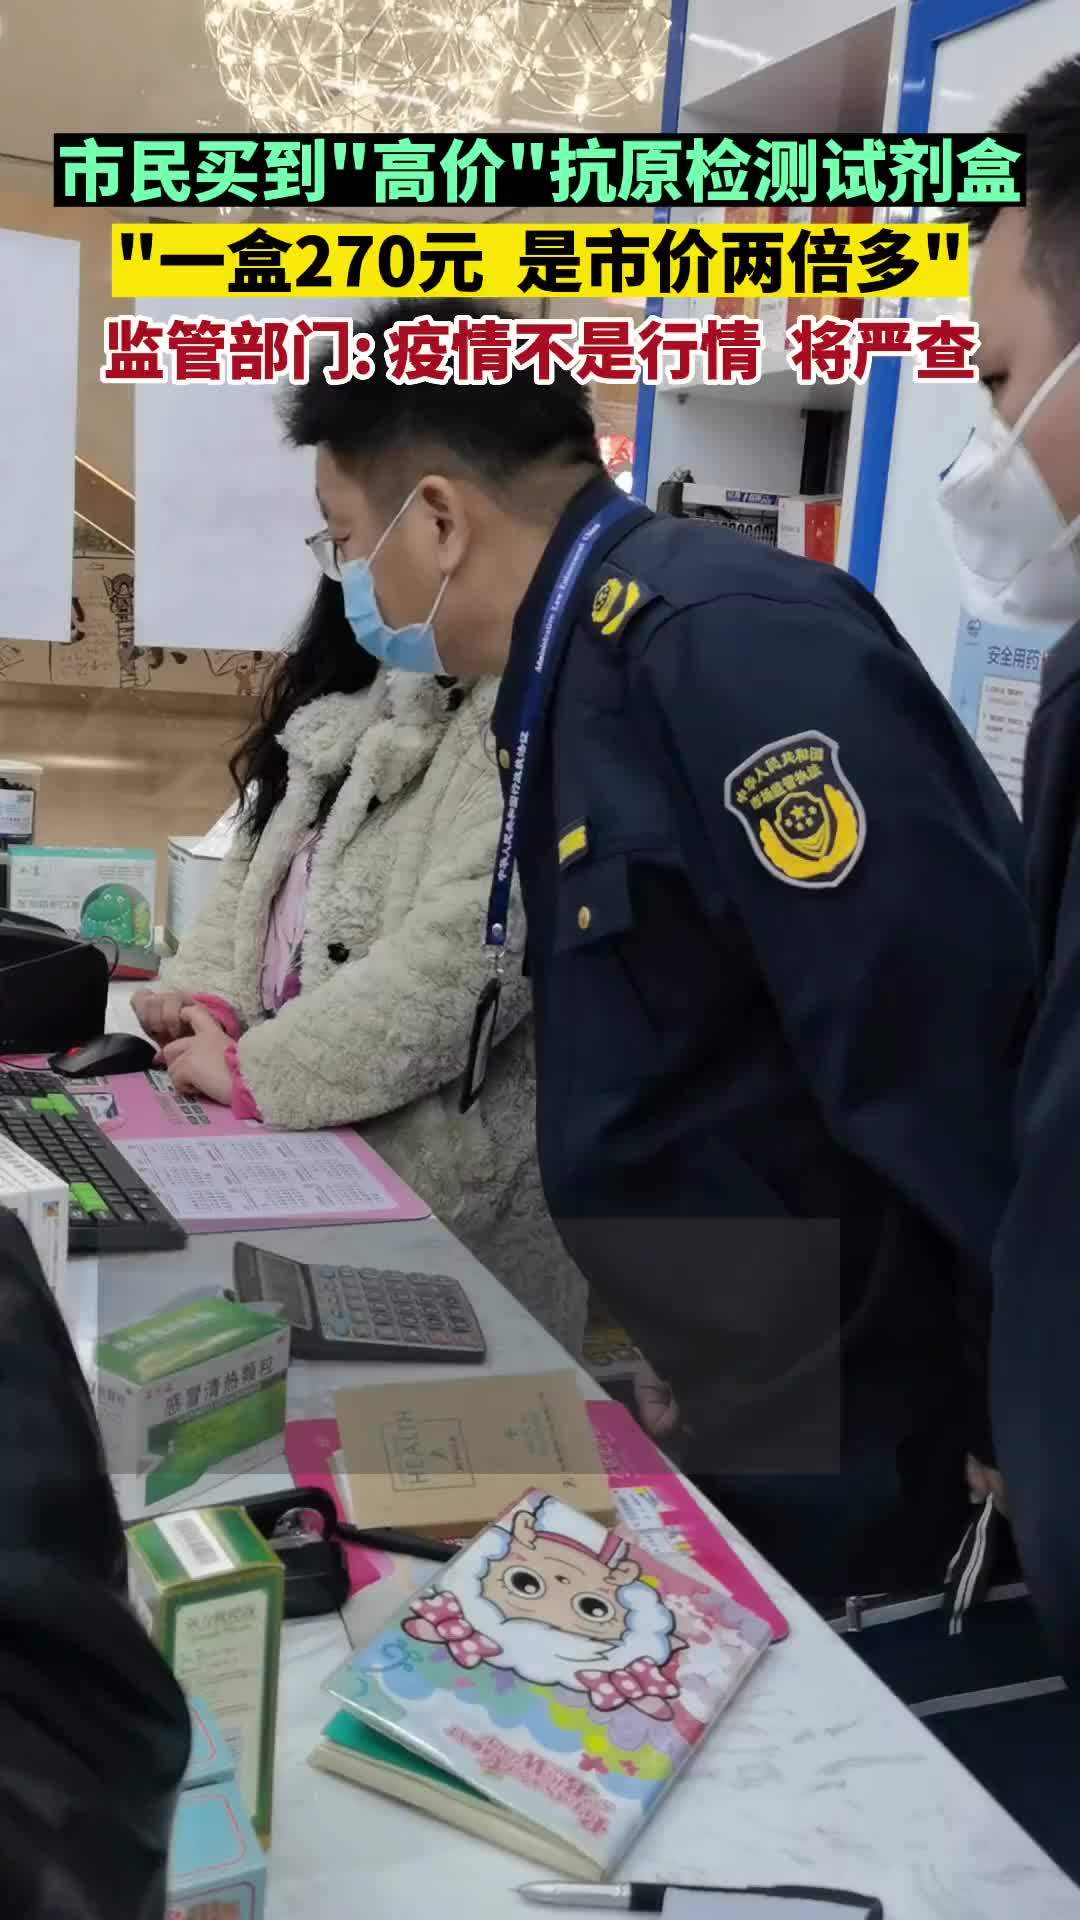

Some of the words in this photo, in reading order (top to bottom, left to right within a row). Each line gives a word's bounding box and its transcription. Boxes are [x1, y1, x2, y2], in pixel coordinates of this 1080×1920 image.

[986, 645, 1041, 671] 安全用药
[736, 746, 824, 804] 中华人民共和国
